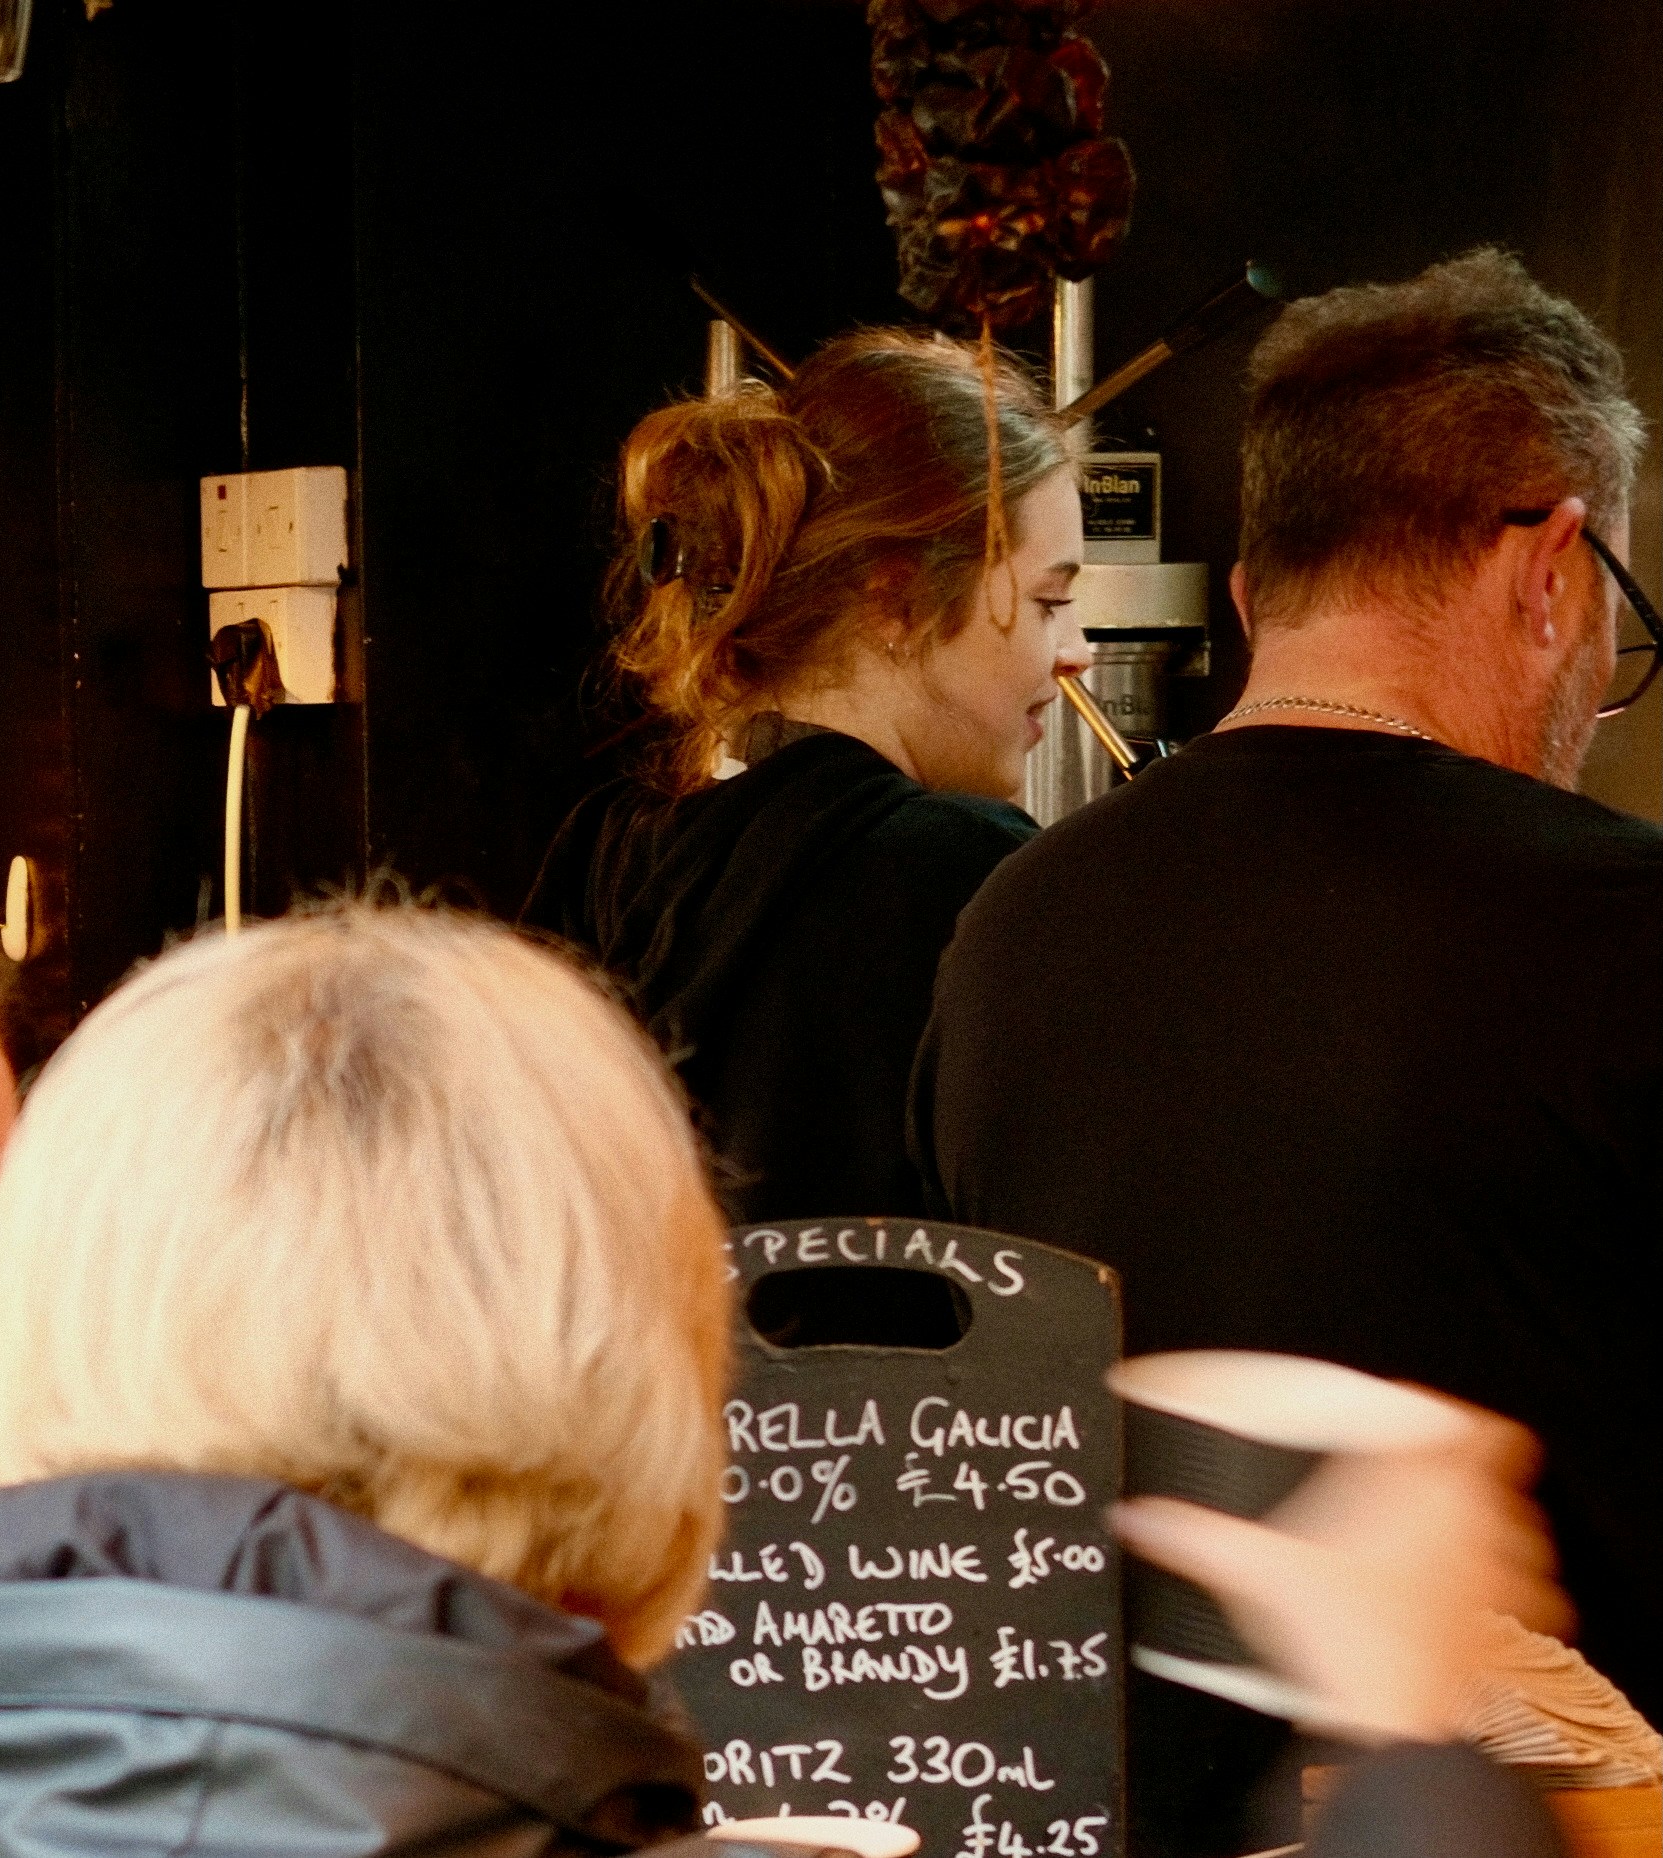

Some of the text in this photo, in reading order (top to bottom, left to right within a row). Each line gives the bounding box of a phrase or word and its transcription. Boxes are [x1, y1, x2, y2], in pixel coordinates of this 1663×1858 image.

[723, 1228, 1025, 1296] PECIALS
[723, 1397, 1080, 1456] RELLA GALICIA
[720, 1452, 1087, 1525] 0.0% £4.50
[848, 1543, 988, 1584] WINE
[1007, 1528, 1105, 1589] £5.00
[752, 1600, 953, 1648] AMARETTO
[730, 1626, 1109, 1701] OR BRANDY £1.75
[955, 1794, 1113, 1858] £4.25
